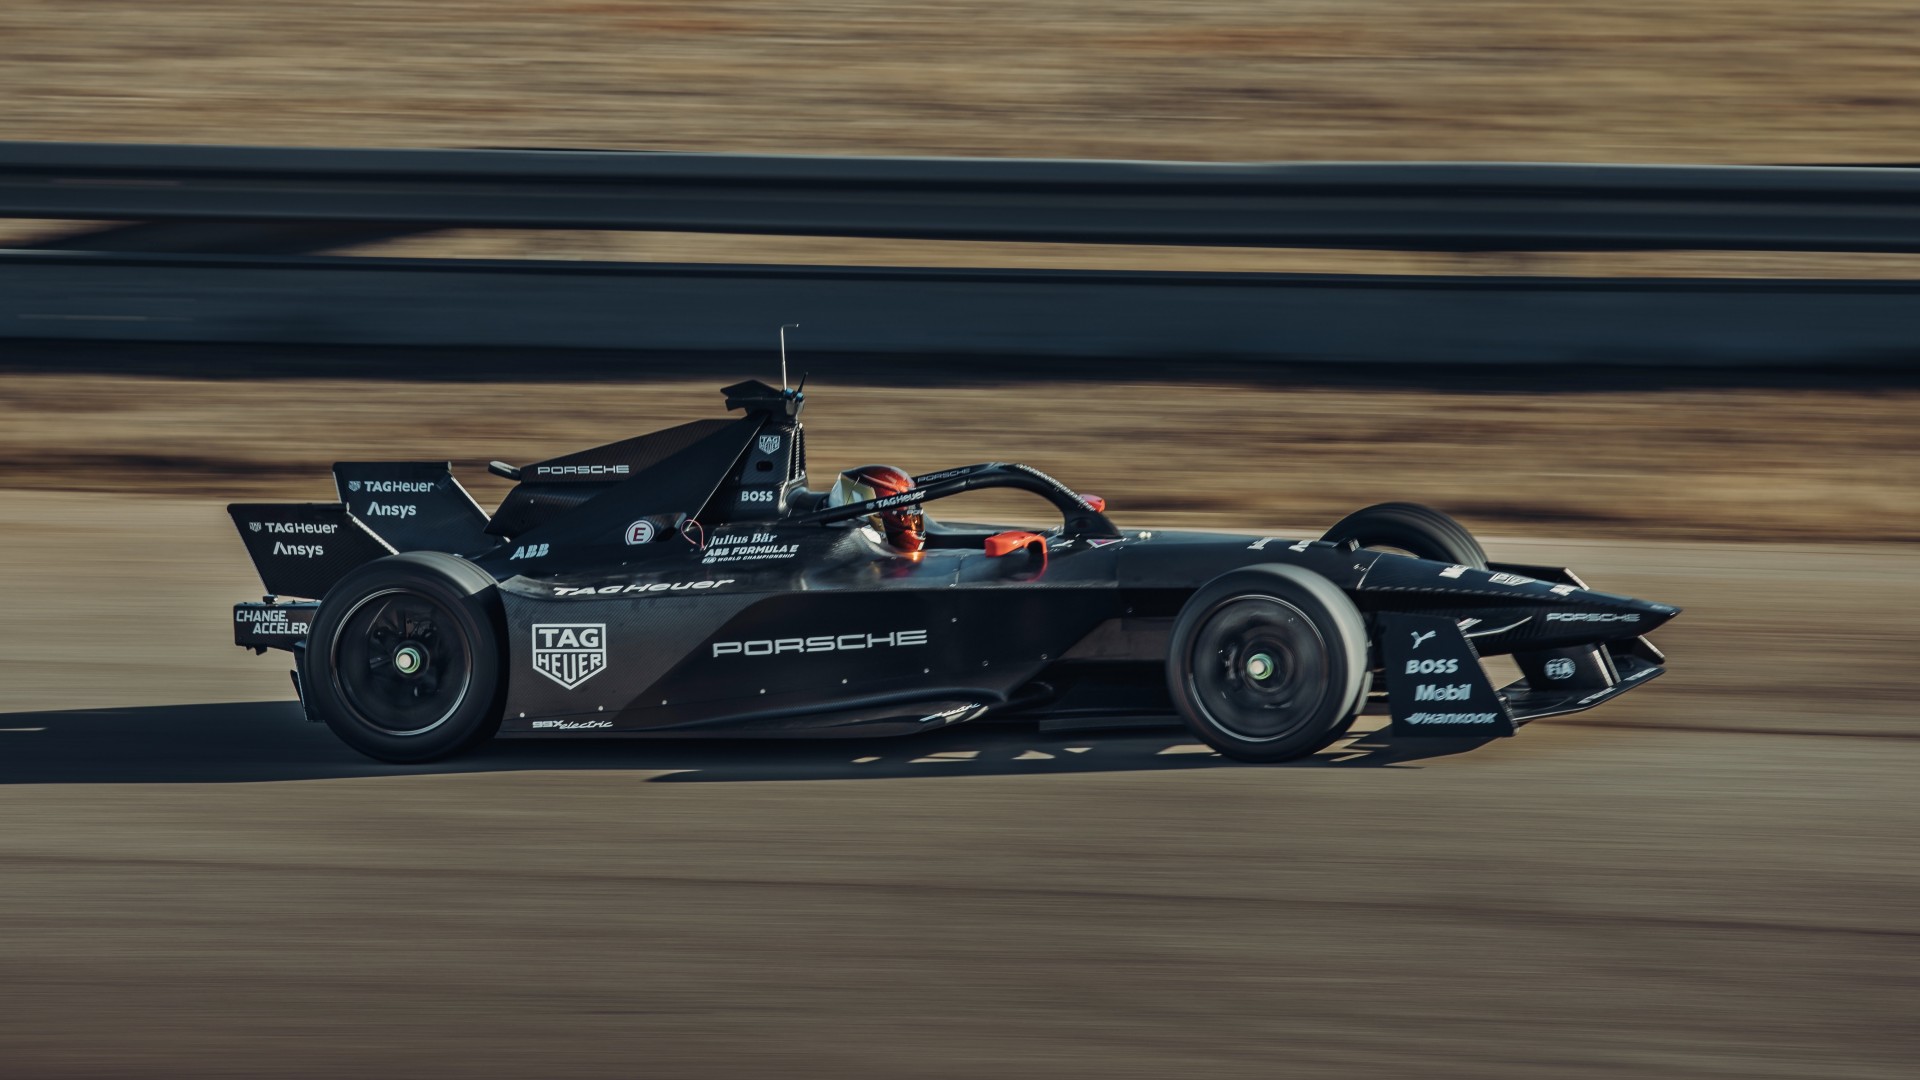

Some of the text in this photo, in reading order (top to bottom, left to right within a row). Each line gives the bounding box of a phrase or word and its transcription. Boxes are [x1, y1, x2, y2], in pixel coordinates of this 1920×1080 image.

[537, 465, 630, 475] PORSCHE
[917, 467, 971, 483] PORSCHE
[741, 490, 774, 502] BOSS
[366, 501, 417, 519] Ansys
[632, 527, 647, 542] E
[708, 532, 778, 548] Julius Bär
[273, 541, 324, 559] Ansys
[509, 543, 549, 561] ABB
[704, 544, 800, 558] ABB FORMULA E
[742, 553, 795, 561] CHAMPIONSHIP
[235, 610, 289, 622] CHANGE.
[1546, 612, 1641, 622] PORSCHE
[252, 622, 310, 635] ACCELER
[538, 628, 600, 648] TAG
[712, 629, 928, 658] PORSCHE
[537, 652, 602, 684] HEUER
[1405, 658, 1460, 675] BOSS
[1414, 683, 1472, 702] Mobil
